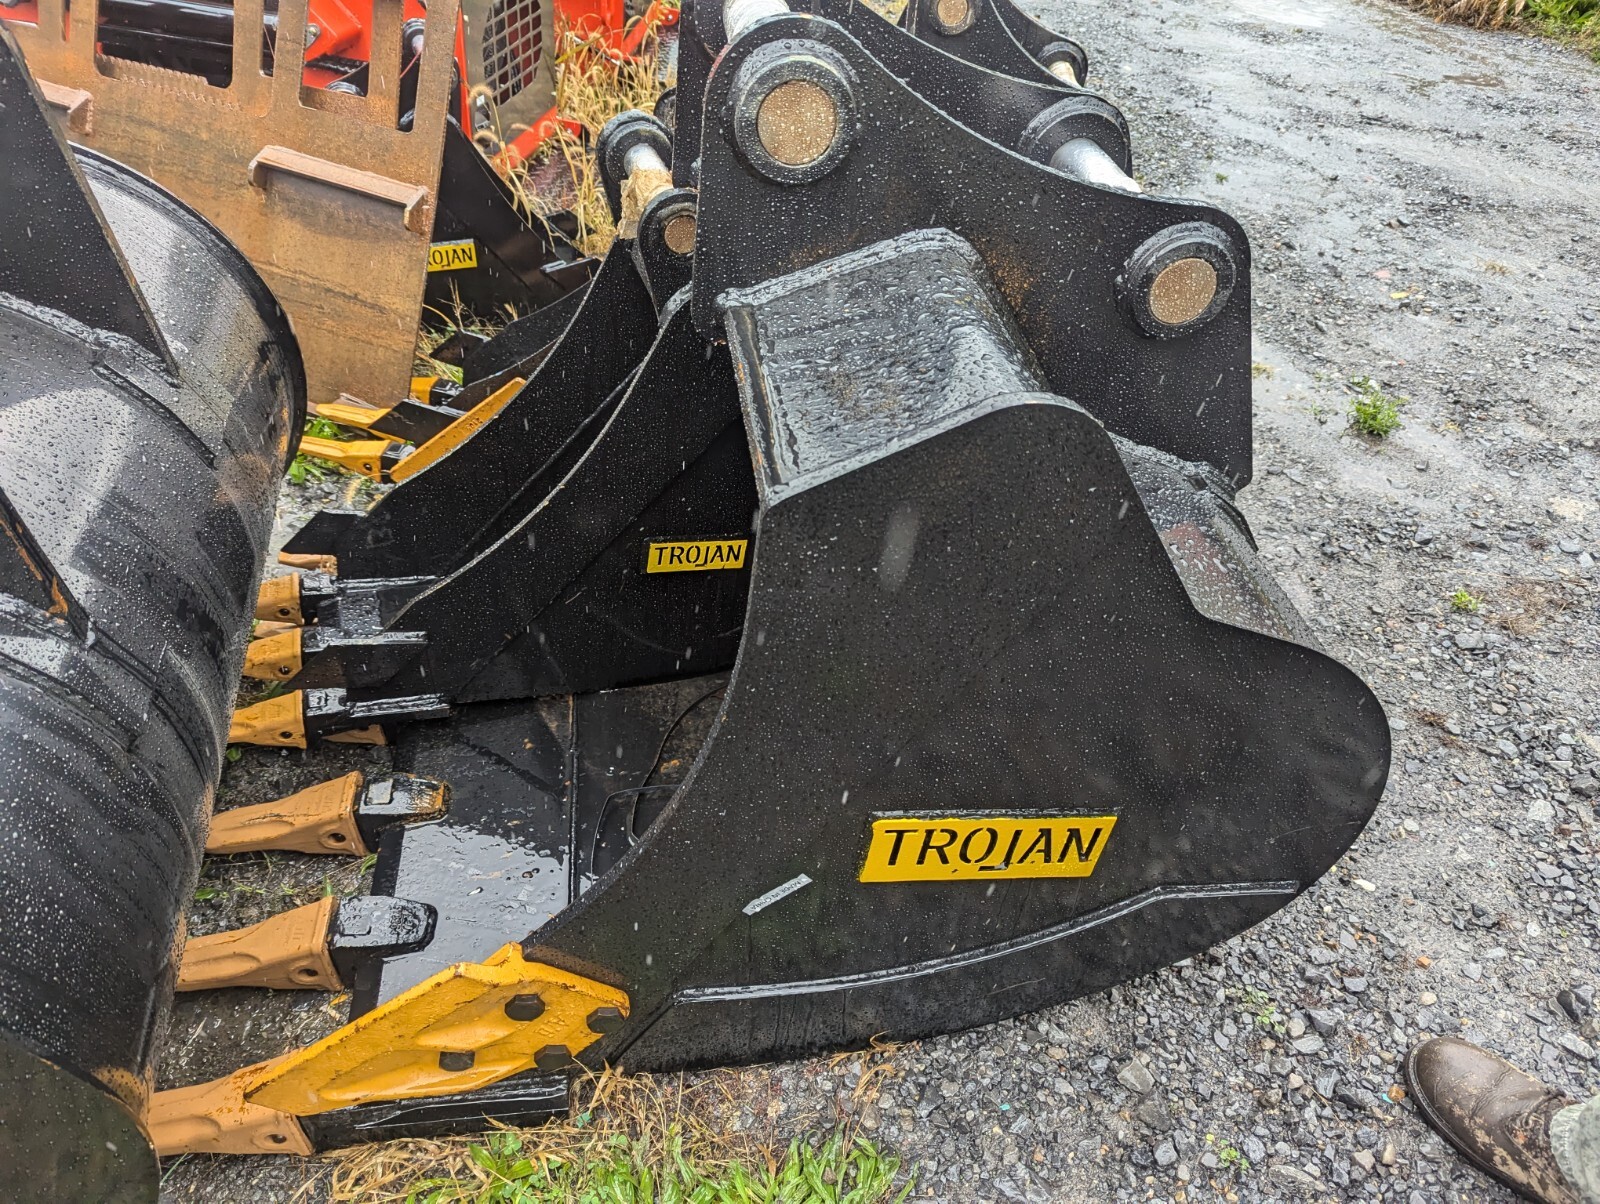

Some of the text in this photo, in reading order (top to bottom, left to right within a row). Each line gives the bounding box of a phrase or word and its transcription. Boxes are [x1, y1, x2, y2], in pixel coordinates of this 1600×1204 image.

[428, 248, 473, 267] OJAN
[655, 544, 742, 567] TROJAN
[885, 827, 1103, 872] TROJAN
